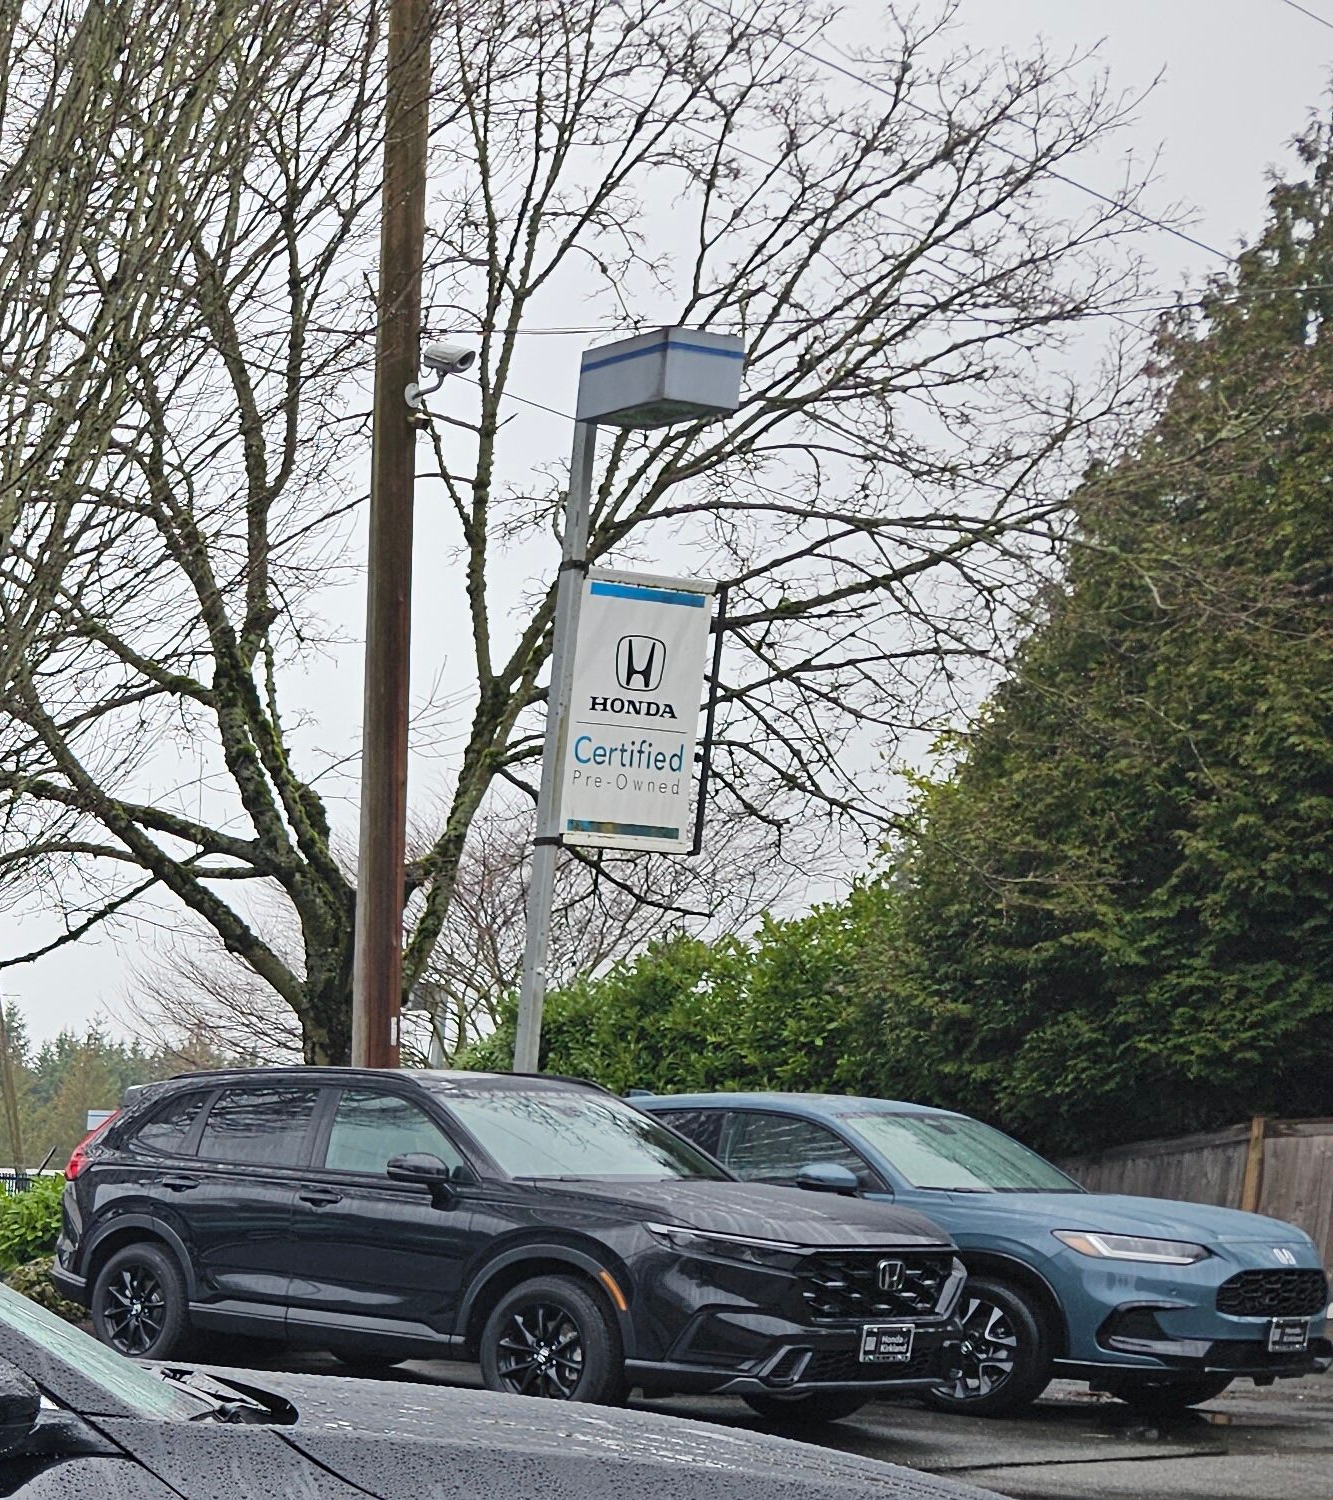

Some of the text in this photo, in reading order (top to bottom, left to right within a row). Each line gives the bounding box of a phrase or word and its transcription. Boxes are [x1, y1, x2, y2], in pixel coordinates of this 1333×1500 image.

[589, 696, 678, 720] HONDA
[574, 735, 684, 773] Certified
[572, 769, 680, 796] Pre-Owned
